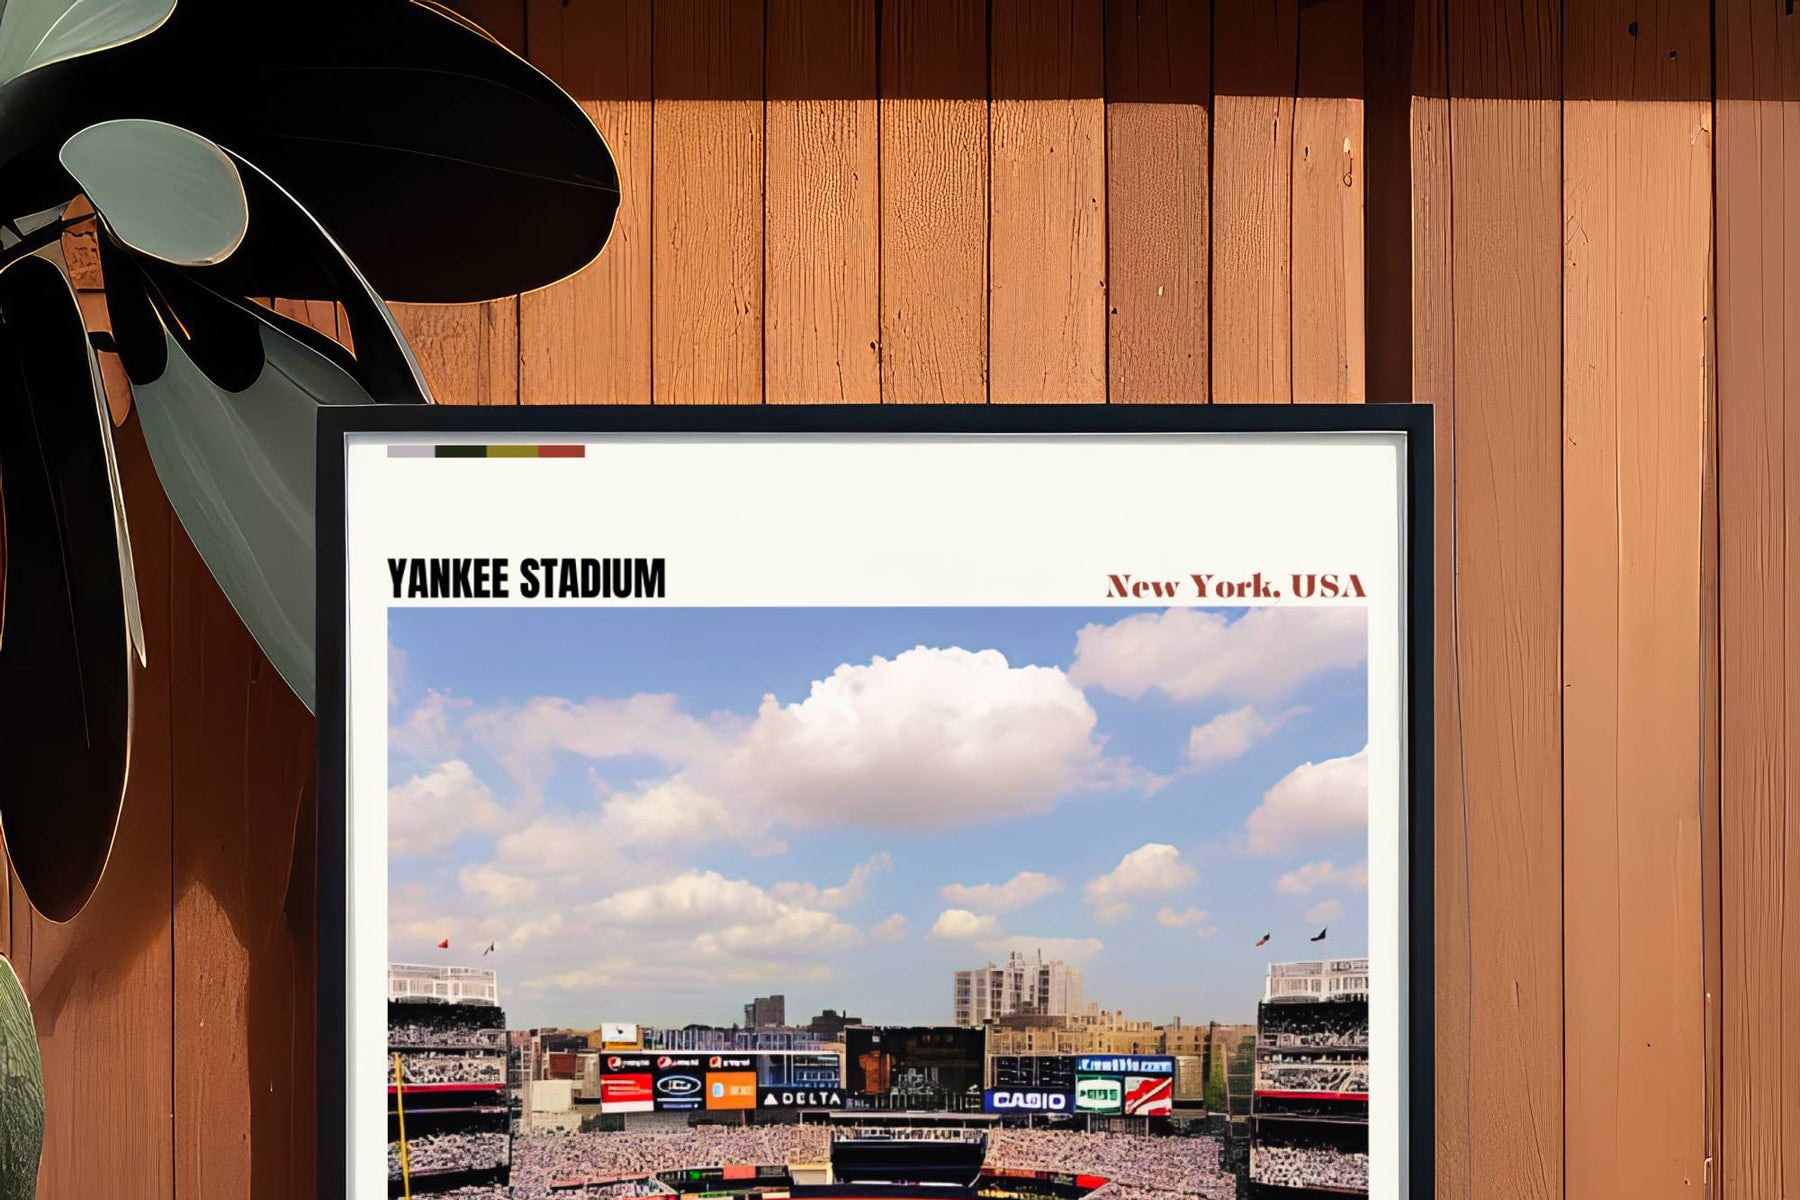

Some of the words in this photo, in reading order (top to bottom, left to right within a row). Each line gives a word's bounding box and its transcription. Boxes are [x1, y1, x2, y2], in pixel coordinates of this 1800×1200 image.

[387, 558, 509, 598] YANKEE
[520, 557, 665, 599] STADIUM
[1106, 574, 1180, 598] New
[1190, 572, 1281, 602] York,
[1291, 574, 1367, 598] USA
[782, 1092, 841, 1105] DELTA
